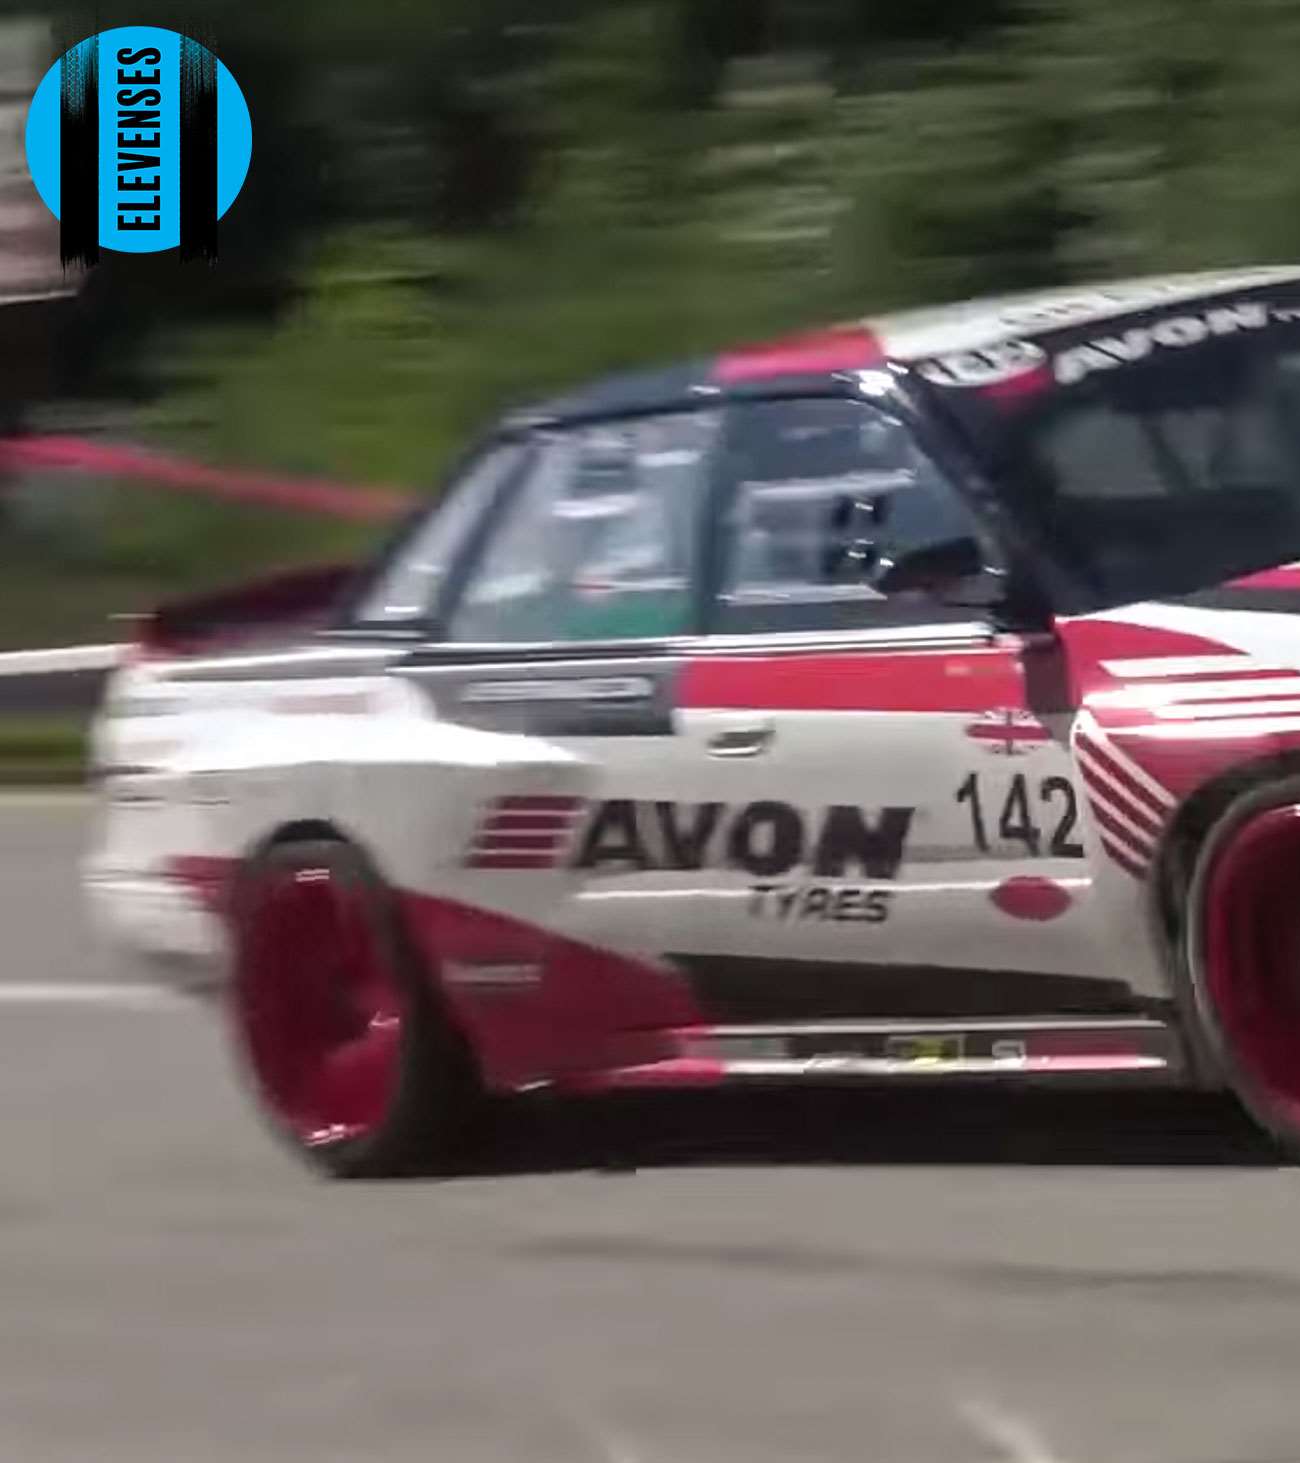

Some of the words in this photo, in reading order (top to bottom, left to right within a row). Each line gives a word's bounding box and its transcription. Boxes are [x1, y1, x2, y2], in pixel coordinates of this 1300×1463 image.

[1053, 301, 1269, 384] AVON
[572, 799, 916, 880] AVON
[956, 772, 1085, 858] 142
[748, 885, 893, 923] TYRES
